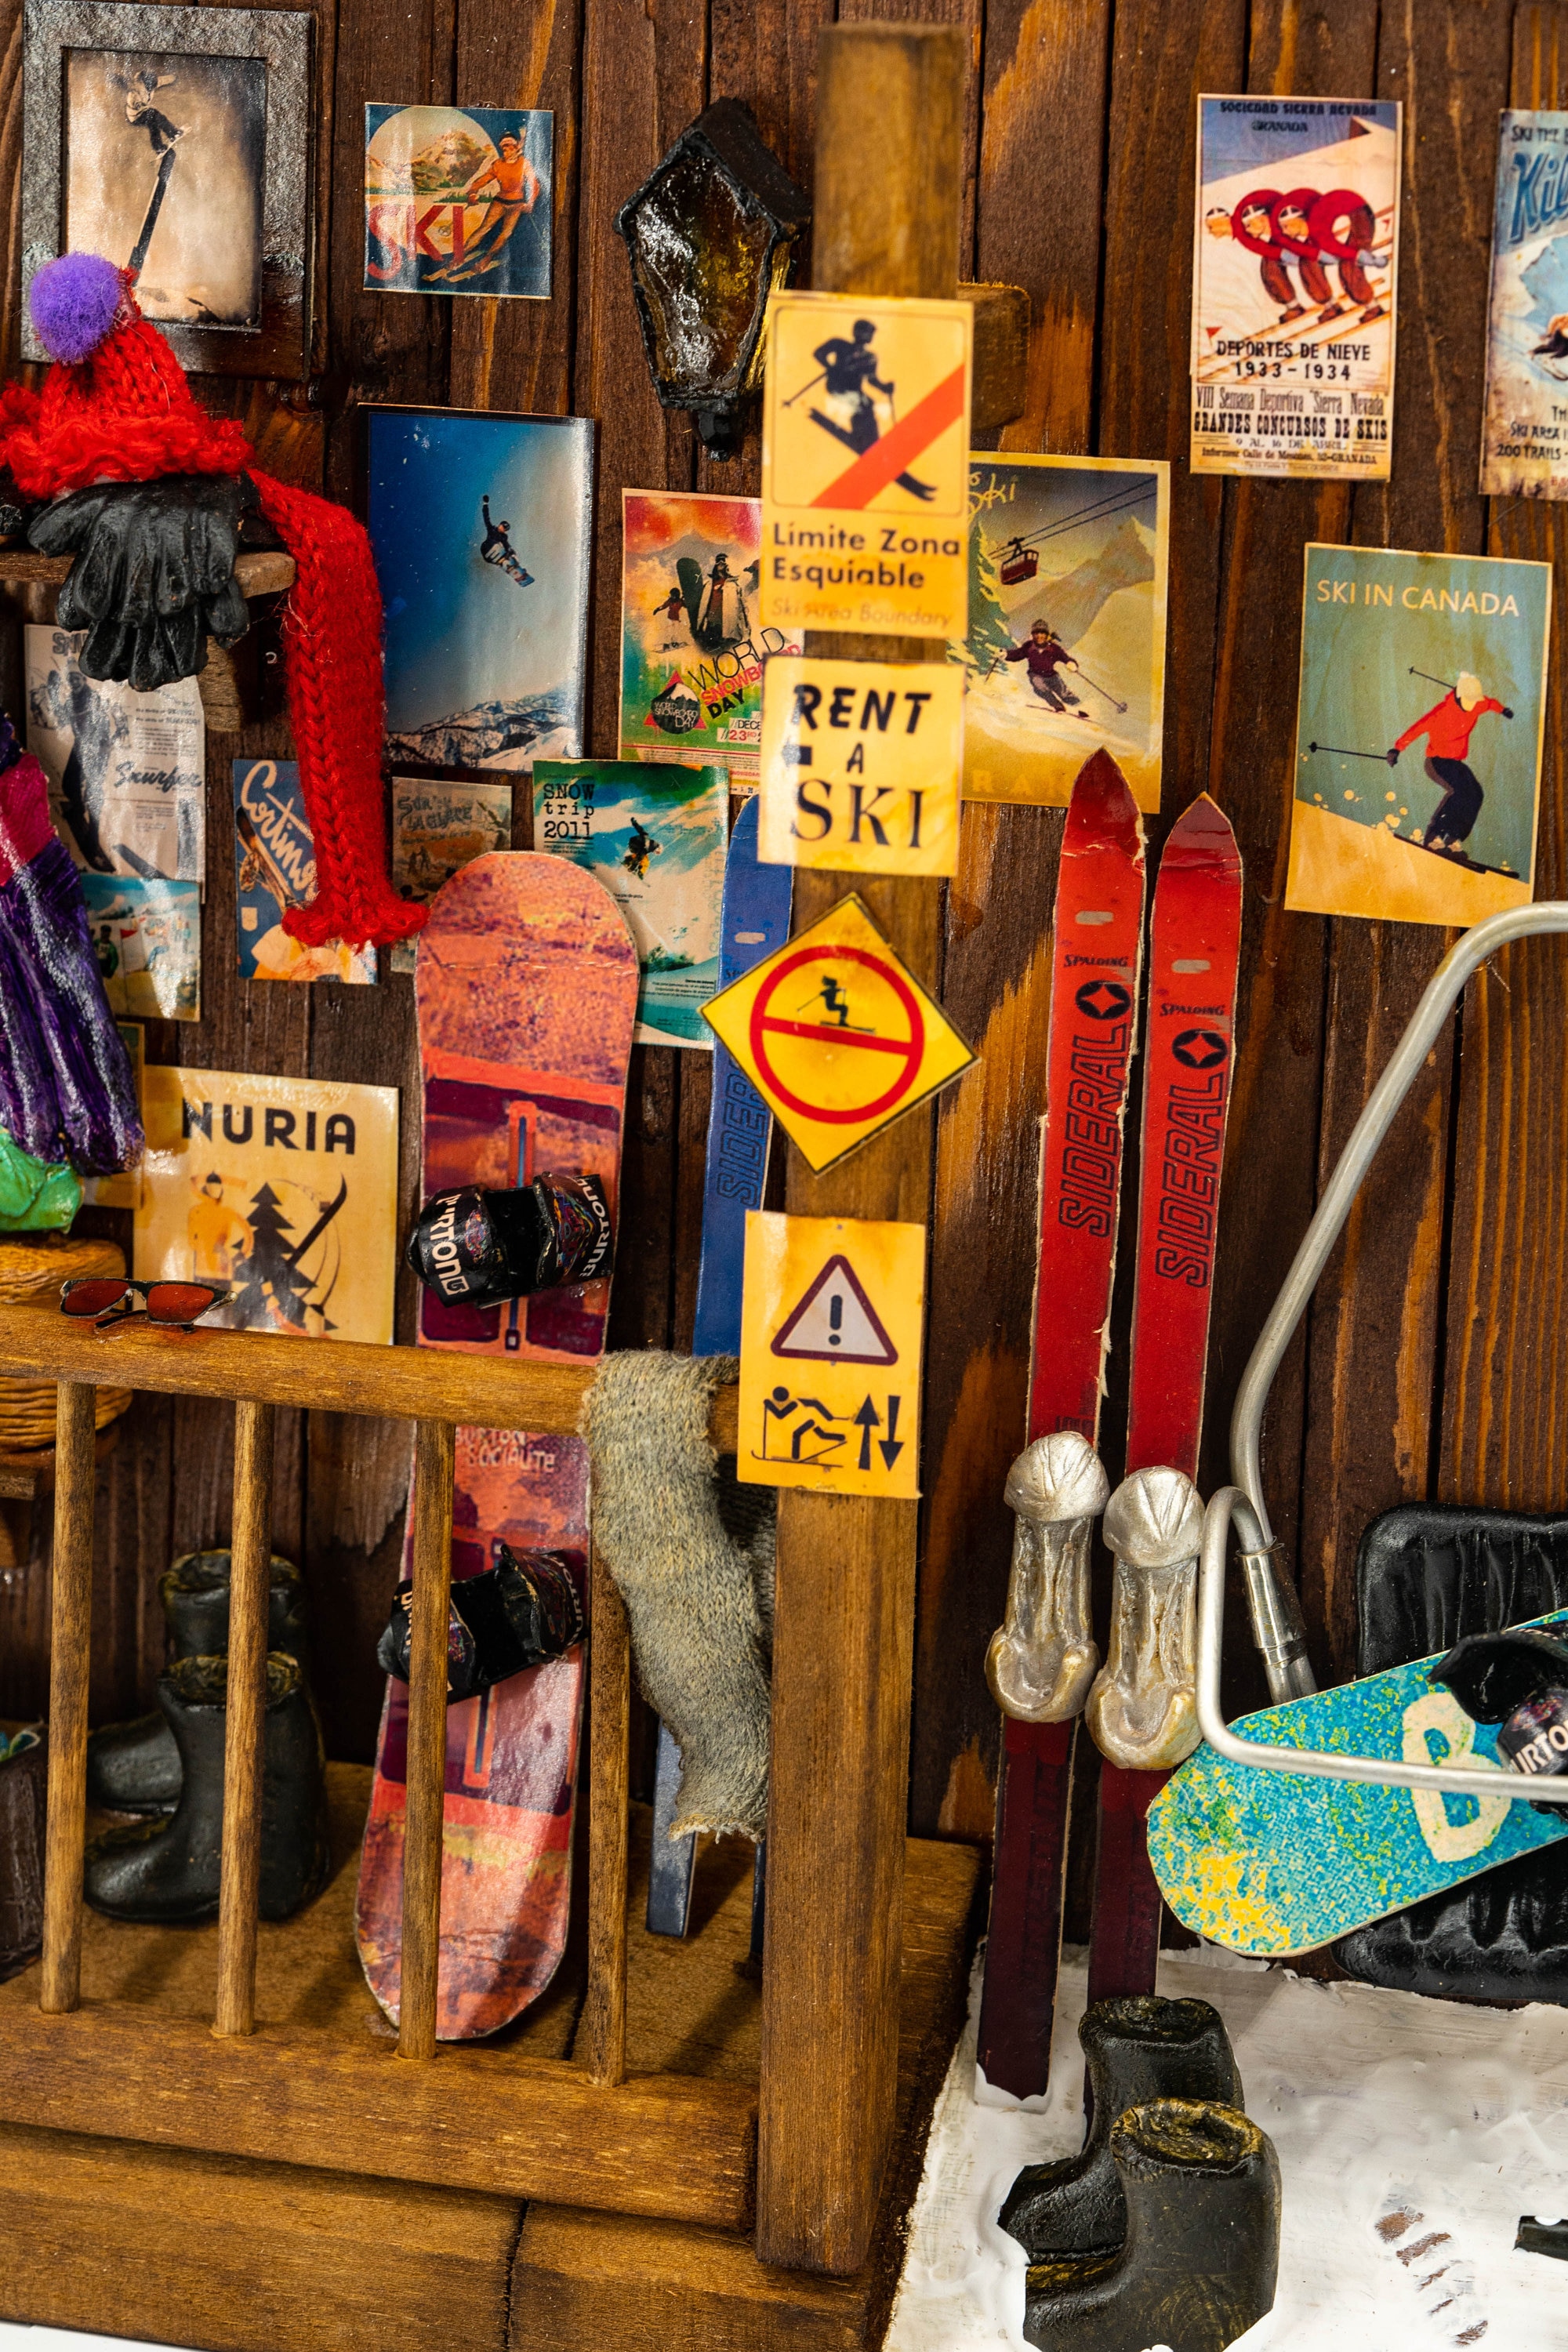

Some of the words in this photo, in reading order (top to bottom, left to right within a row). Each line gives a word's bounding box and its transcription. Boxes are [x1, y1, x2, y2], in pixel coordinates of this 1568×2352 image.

[1283, 103, 1324, 115] SIERRA
[367, 204, 465, 280] SKI
[1216, 340, 1293, 358] DEPORTES
[1300, 343, 1319, 359] DE
[1327, 344, 1370, 361] NIEVE
[1236, 361, 1281, 378] 1933
[1305, 363, 1351, 381] 1934
[1197, 386, 1214, 408] VIII
[1219, 387, 1254, 410] Semana
[1194, 412, 1250, 435] GRANDES
[1257, 414, 1327, 437] CONCURSOS
[1335, 417, 1350, 438] DE
[1357, 419, 1387, 441] SKIS
[1497, 444, 1520, 457] 200
[880, 528, 960, 556] Zona
[774, 557, 925, 590] Esquiable
[1317, 579, 1356, 604] SKI
[1364, 583, 1393, 608] IN
[1402, 586, 1519, 617] CANADA
[858, 601, 952, 630] Boundary
[688, 628, 785, 691] WORLD
[706, 688, 745, 719] DAY
[794, 684, 932, 735] RENT
[846, 741, 864, 774] A
[543, 783, 595, 800] SNOW
[543, 801, 595, 819] trip
[790, 779, 925, 848] SKI
[544, 820, 594, 840] 2011
[1063, 953, 1129, 968] SPALDING
[1160, 1002, 1226, 1017] SPALDING
[183, 1098, 357, 1155] NURIA
[717, 1058, 766, 1207] SIDER
[1058, 1022, 1128, 1239] SIDERAL
[1155, 1072, 1225, 1288] SIDERAL
[1511, 1719, 1568, 1774] URTO
